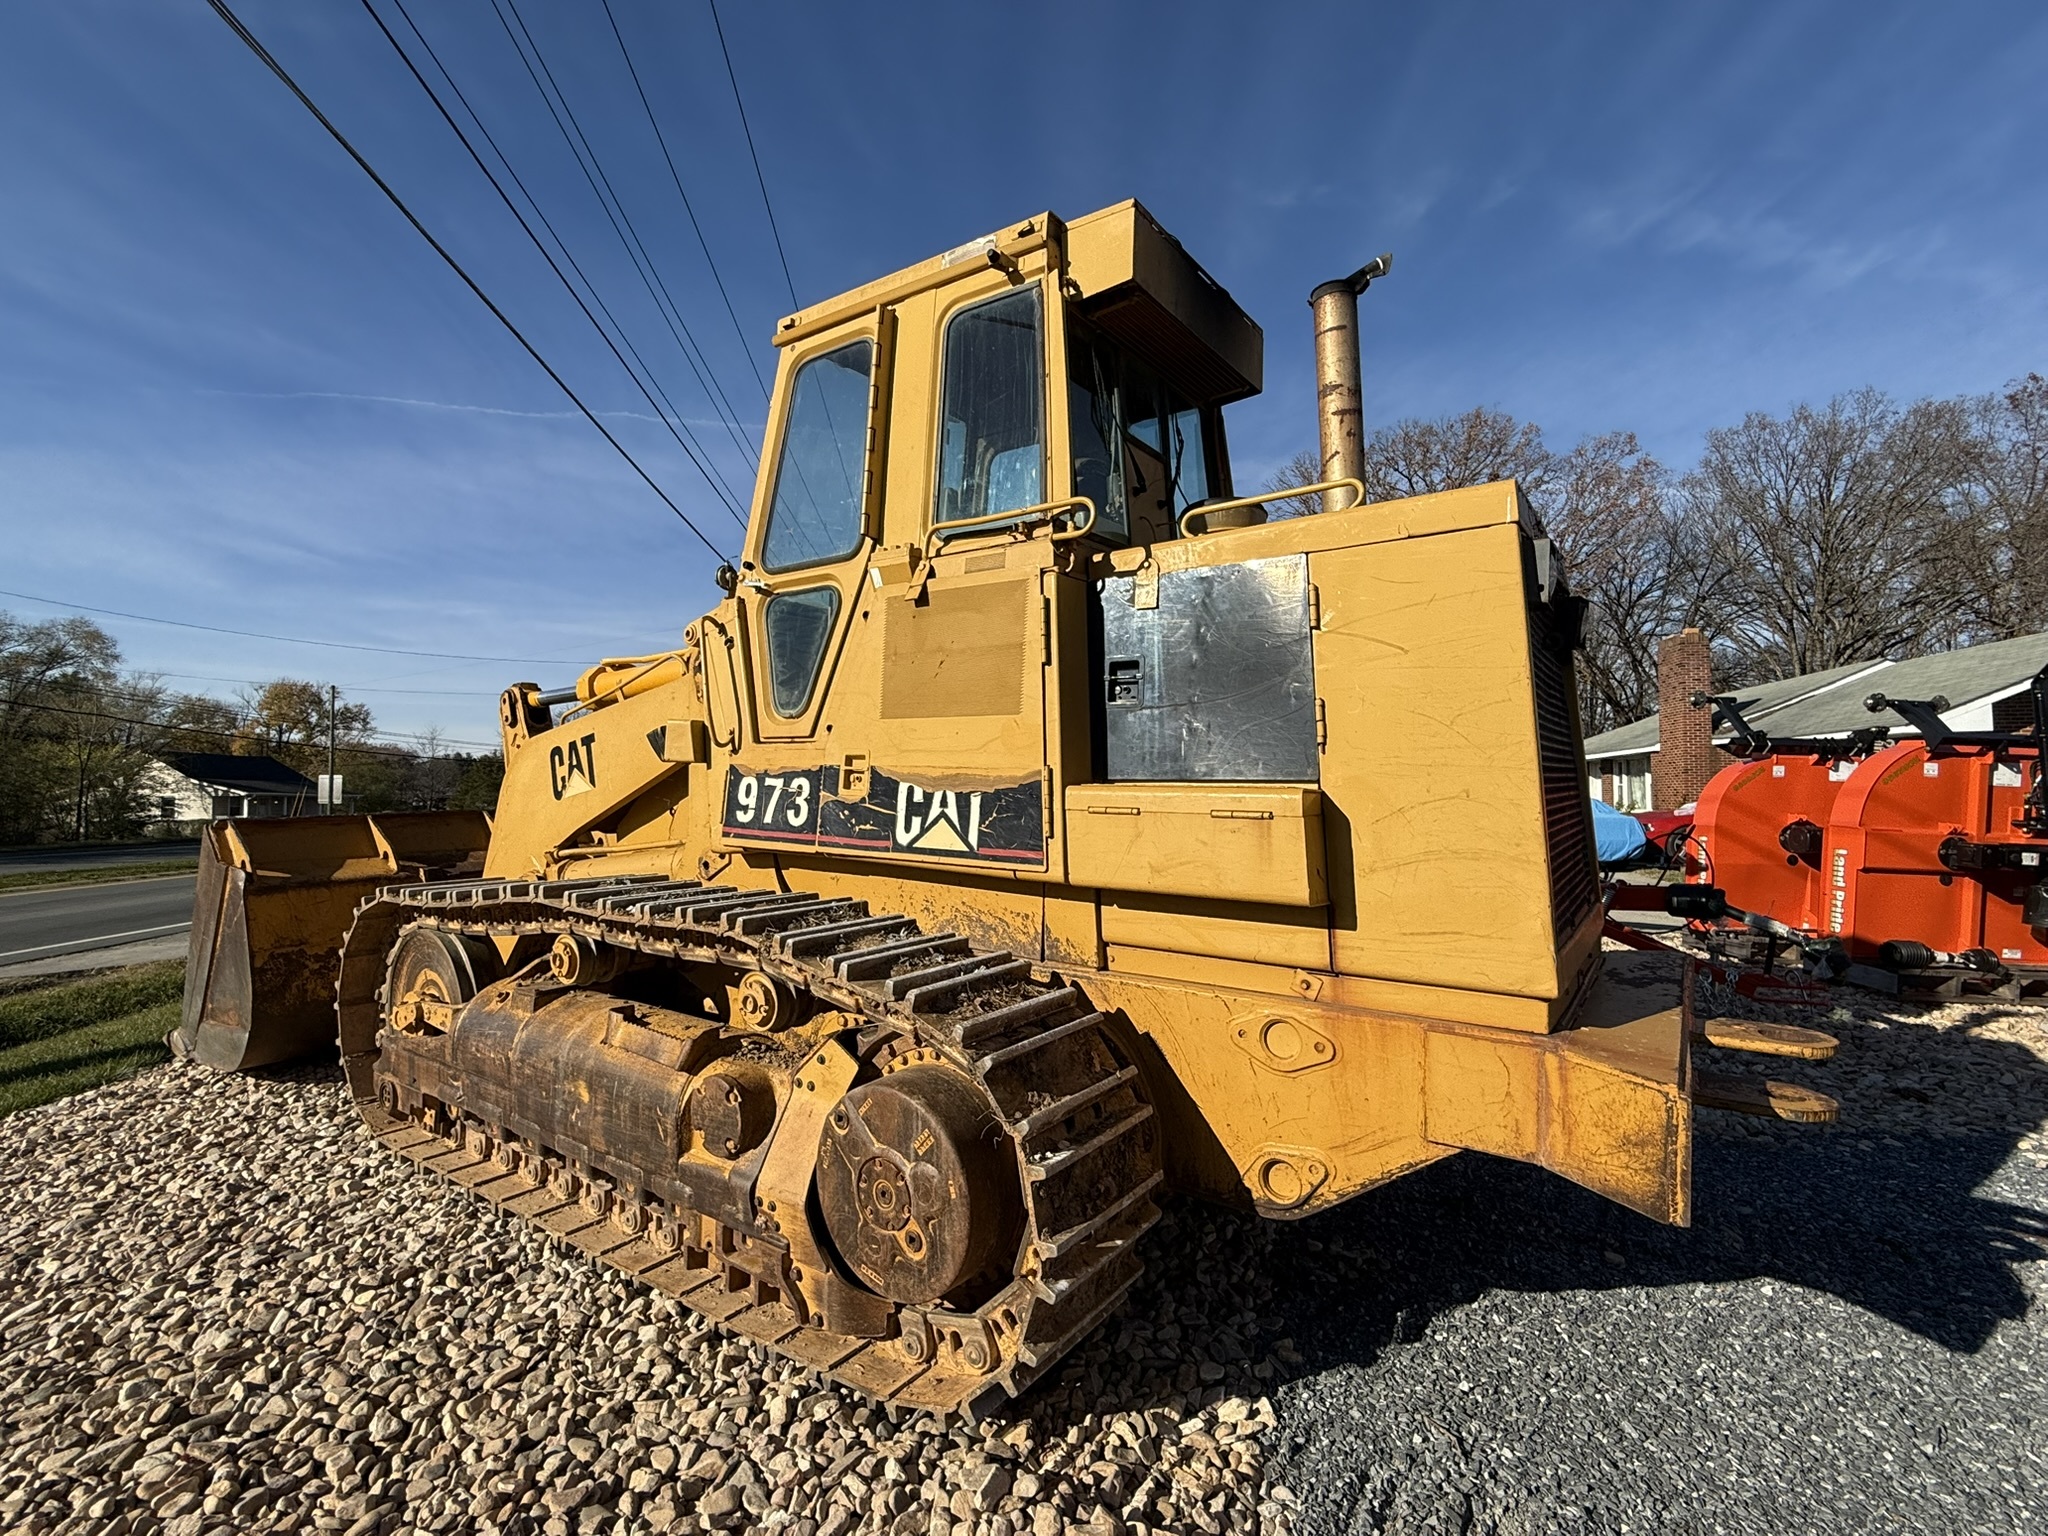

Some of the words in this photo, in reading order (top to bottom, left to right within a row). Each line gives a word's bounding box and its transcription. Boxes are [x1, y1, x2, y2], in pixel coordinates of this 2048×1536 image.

[550, 732, 596, 801] CAT
[736, 776, 810, 827] 973
[895, 782, 982, 851] CAT
[1832, 848, 1848, 888] Land
[1830, 889, 1846, 934] Pride
